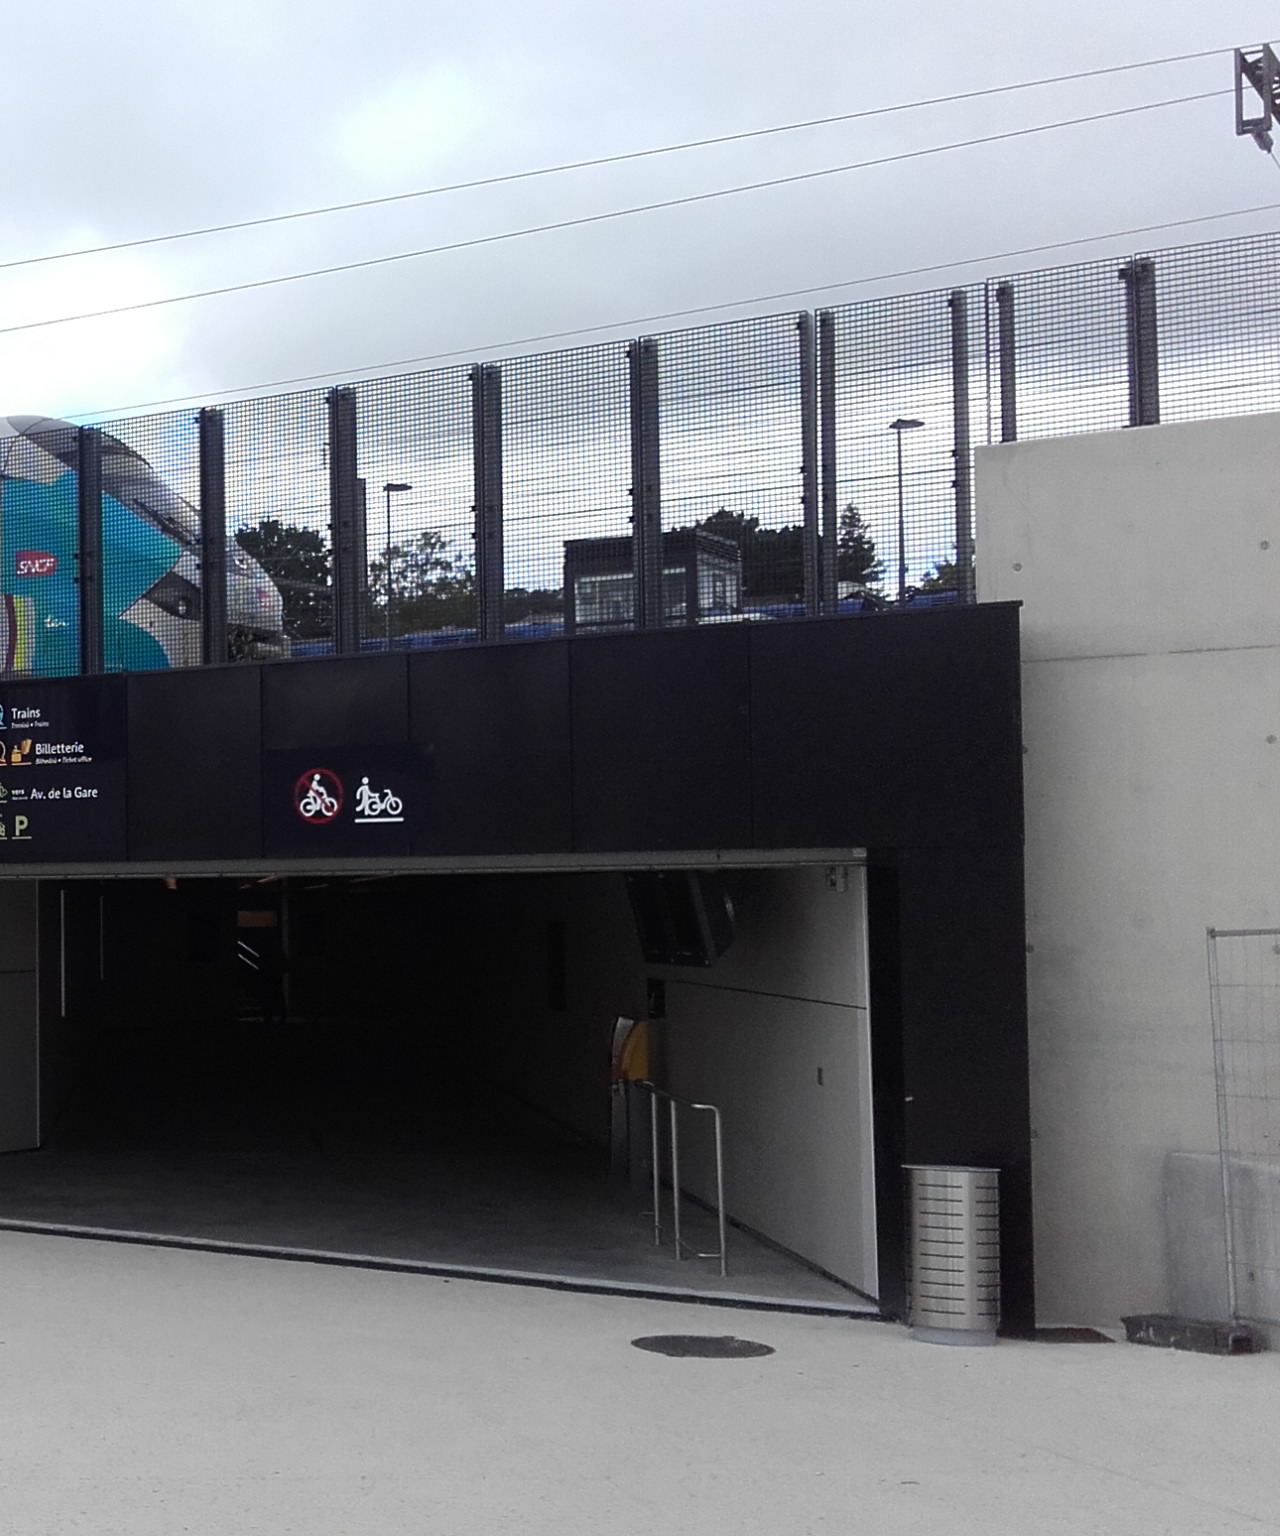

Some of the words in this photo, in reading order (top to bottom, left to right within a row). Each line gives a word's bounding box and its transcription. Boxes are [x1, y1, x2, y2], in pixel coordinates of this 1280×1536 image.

[16, 557, 55, 575] SNCF
[11, 707, 40, 719] Trains
[35, 741, 84, 754] Billetterie
[30, 788, 47, 800] Av.
[48, 787, 62, 799] de
[63, 787, 73, 799] la
[74, 786, 98, 798] Gare
[15, 815, 29, 836] P
